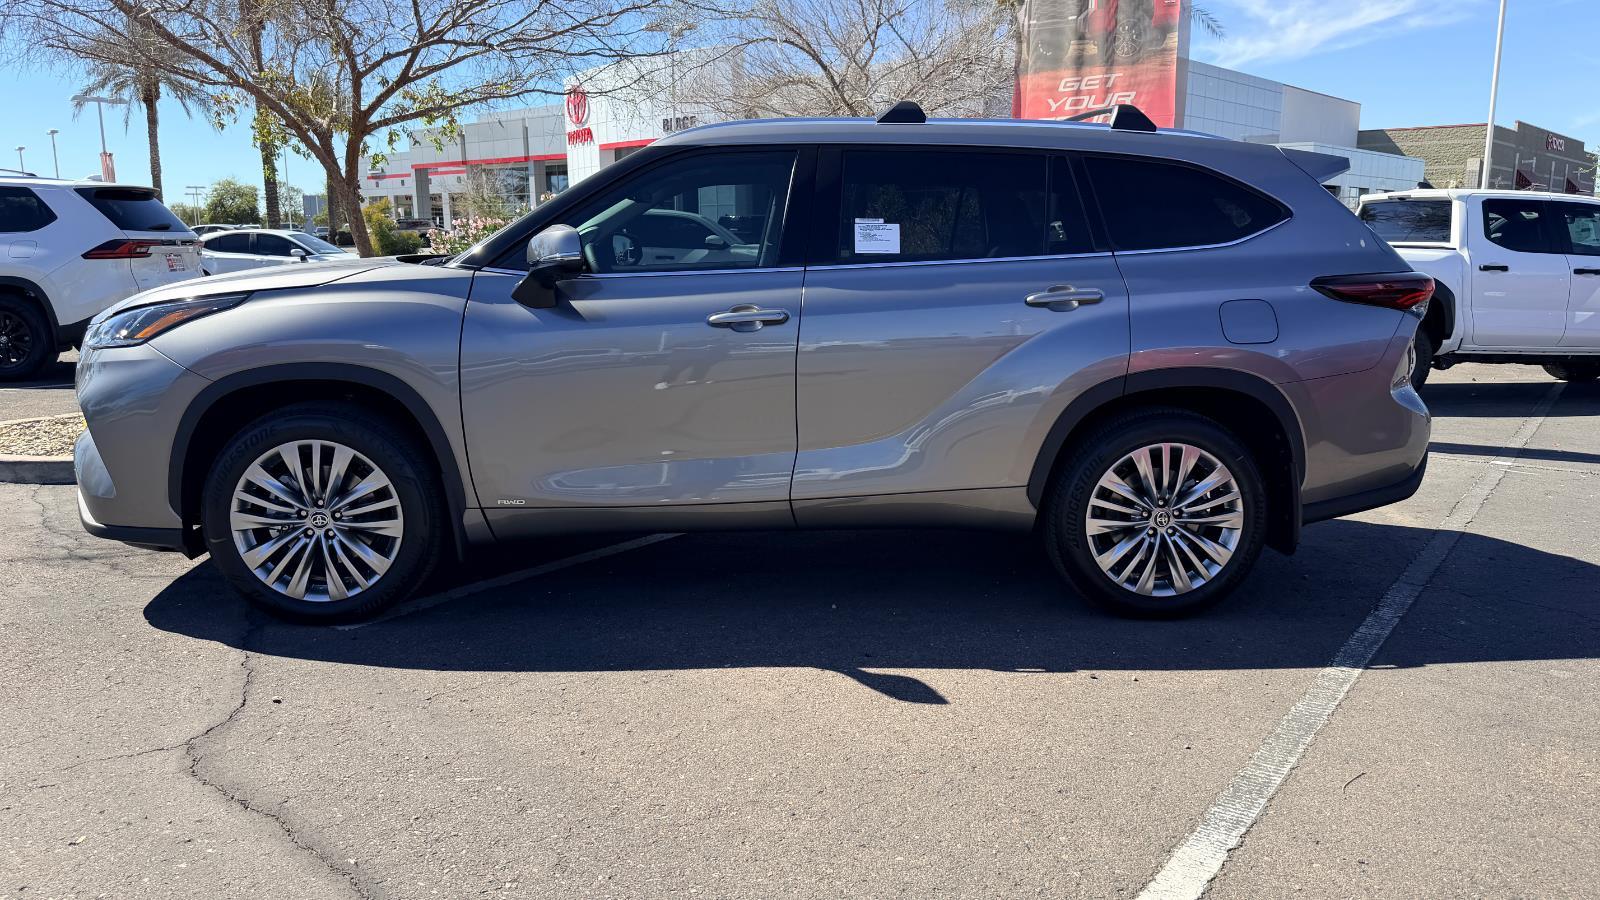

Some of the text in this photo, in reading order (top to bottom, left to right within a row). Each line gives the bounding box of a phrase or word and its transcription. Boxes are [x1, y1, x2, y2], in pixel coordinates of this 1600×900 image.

[1058, 73, 1123, 92] GET
[1047, 91, 1136, 112] YOUR
[1064, 451, 1106, 549] BRIDGESTONE
